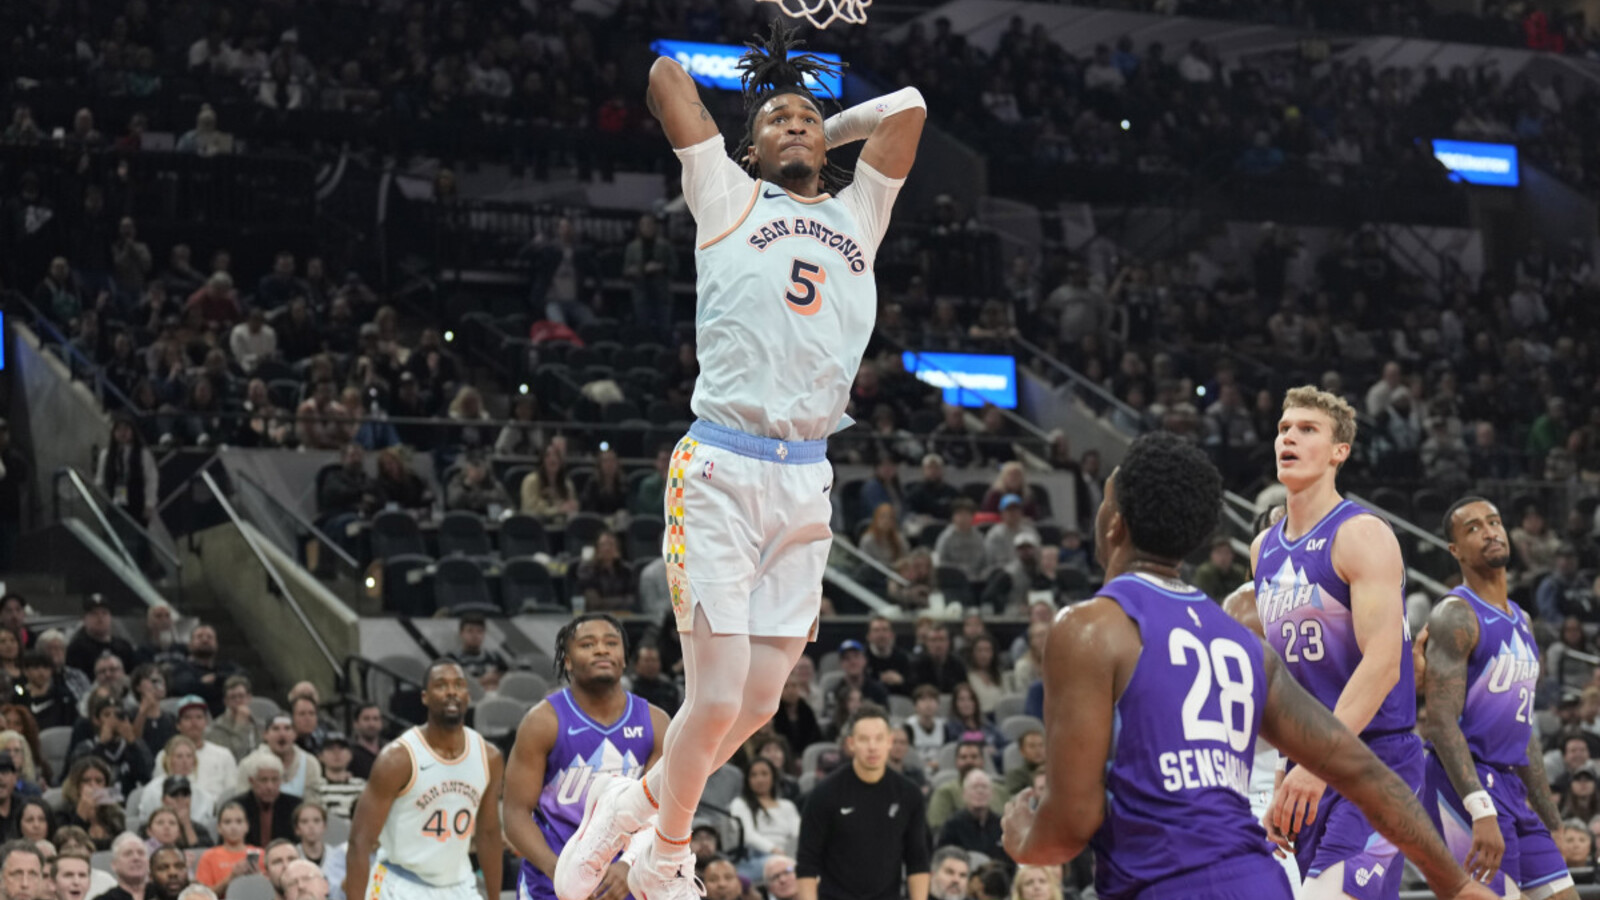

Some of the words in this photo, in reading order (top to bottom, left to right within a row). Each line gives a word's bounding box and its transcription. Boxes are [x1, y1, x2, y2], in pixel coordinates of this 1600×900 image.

[748, 218, 791, 251] SAN
[794, 217, 866, 274] ANTONIO
[784, 258, 824, 313] 5
[1256, 584, 1315, 630] UTAH
[1281, 618, 1325, 663] 23
[1168, 627, 1254, 752] 28
[1488, 652, 1540, 693] UTAH
[415, 786, 440, 810] SAN
[421, 808, 475, 841] 40
